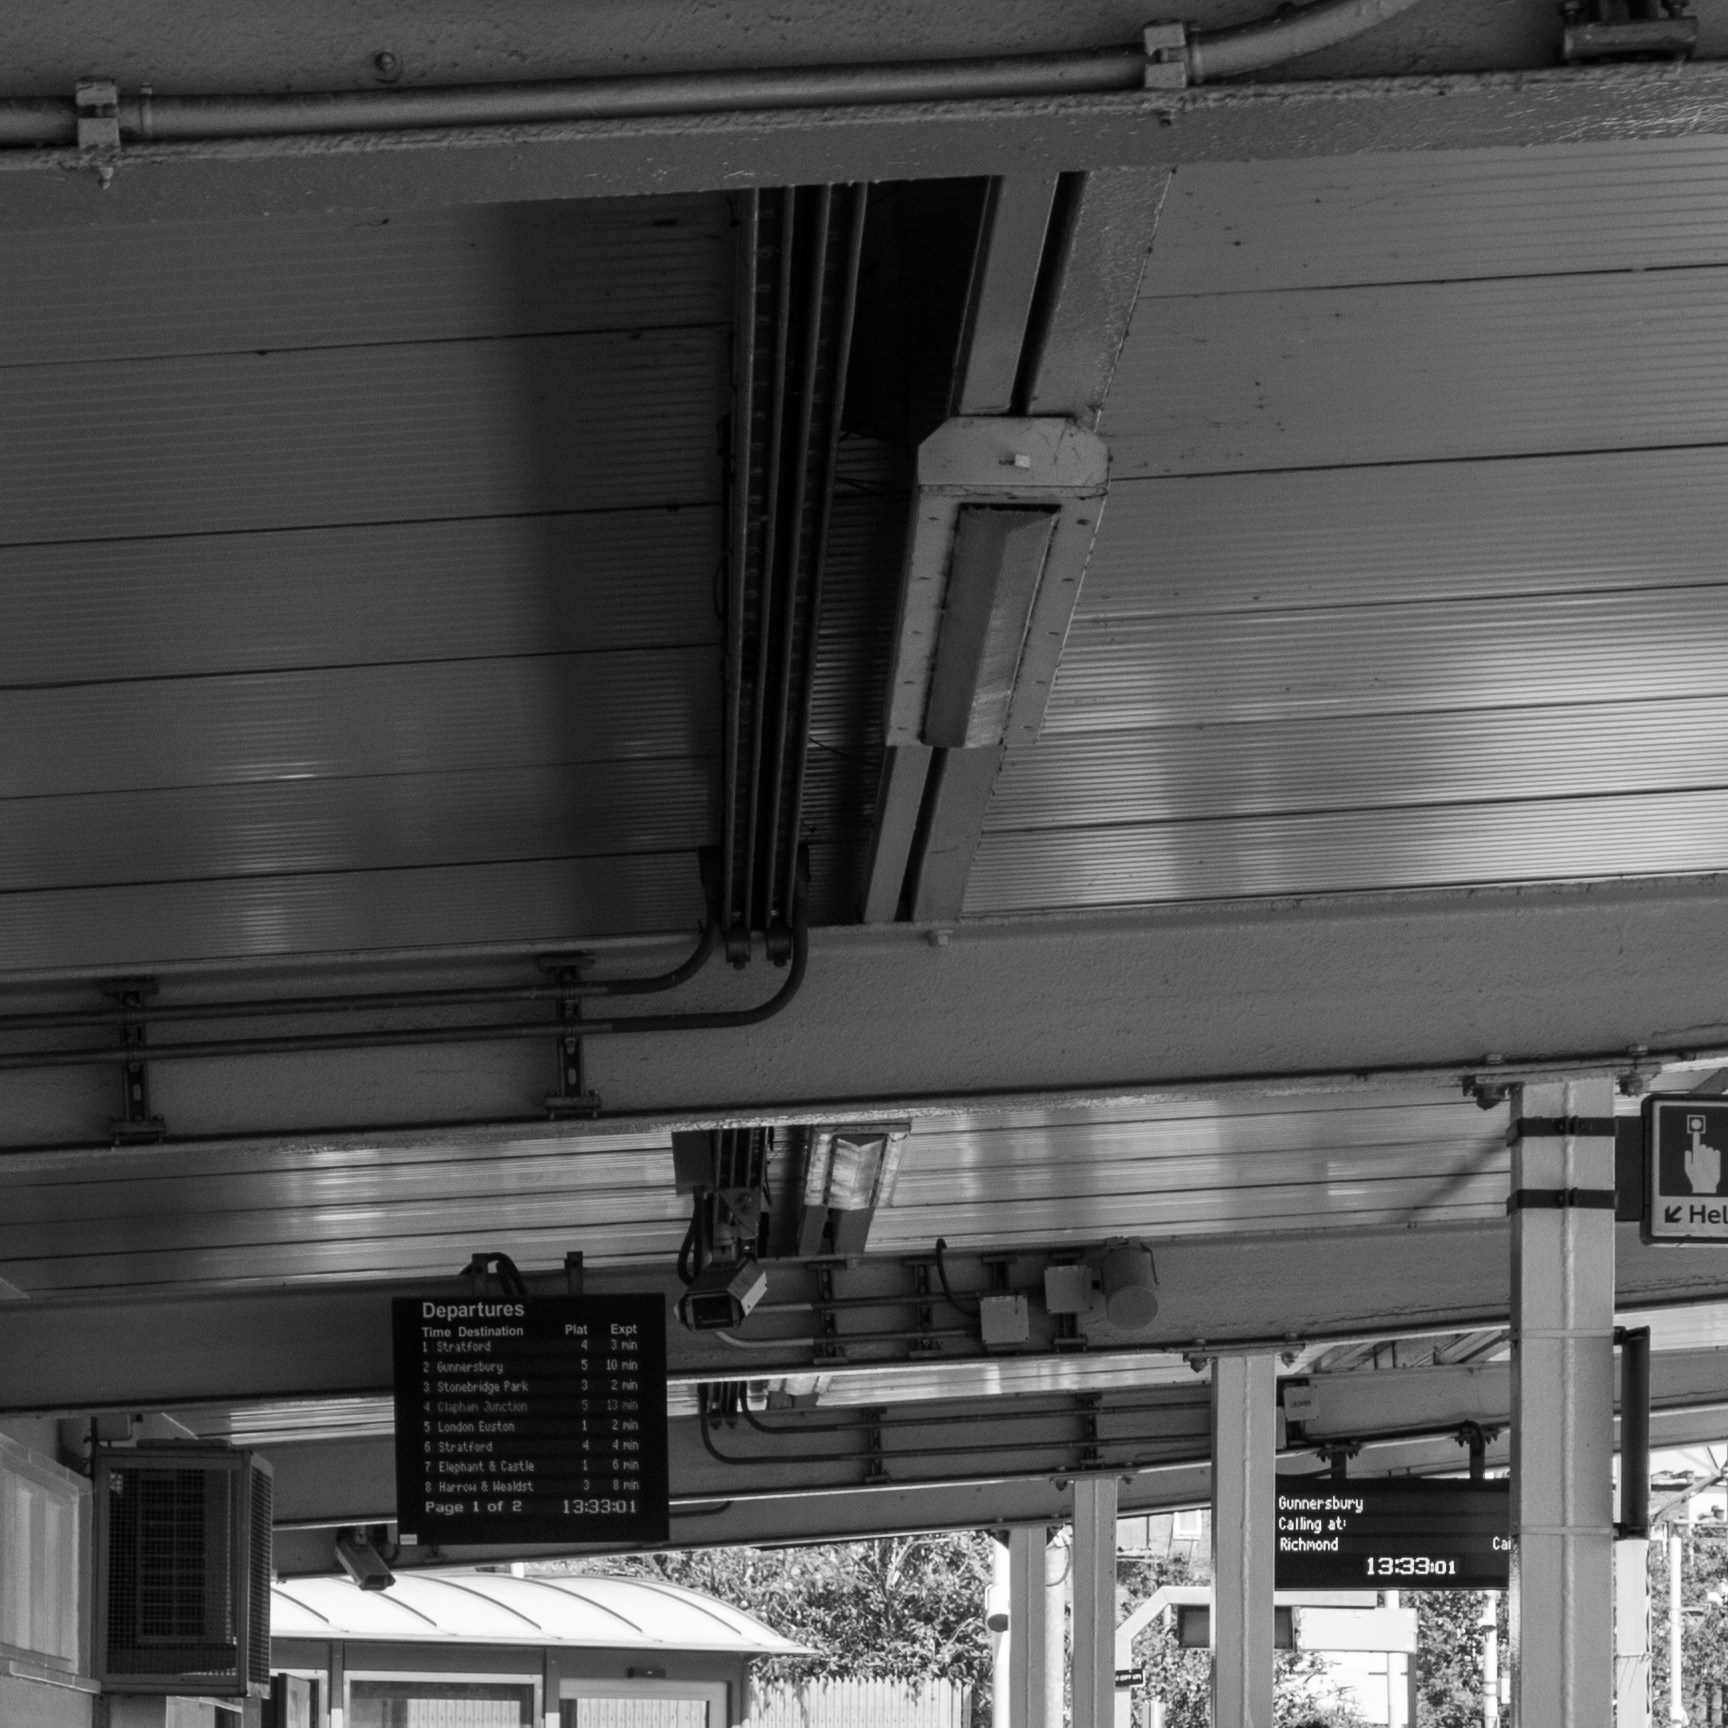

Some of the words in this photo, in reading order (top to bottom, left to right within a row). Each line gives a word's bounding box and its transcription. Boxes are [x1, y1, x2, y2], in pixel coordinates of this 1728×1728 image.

[422, 1302, 525, 1321] Departures
[422, 1327, 451, 1338] Time
[458, 1326, 524, 1337] Destination
[564, 1324, 588, 1335] Plat
[610, 1323, 638, 1337] Expt
[422, 1342, 428, 1353] 1
[436, 1342, 491, 1353] Stratford
[581, 1339, 588, 1350] 4
[611, 1339, 618, 1350] 3
[621, 1339, 638, 1350] min
[423, 1361, 429, 1372] 2
[437, 1361, 503, 1374] Gunnersbury
[581, 1360, 588, 1371] 5
[606, 1360, 618, 1371] 10
[622, 1360, 638, 1370] min
[423, 1381, 430, 1395] 3
[437, 1381, 500, 1395] Stonebridge
[504, 1381, 529, 1395] Park
[582, 1380, 589, 1391] 3
[611, 1380, 619, 1391] 2
[622, 1380, 638, 1391] min
[424, 1401, 430, 1414] 4
[438, 1401, 479, 1414] Clapham
[484, 1401, 528, 1414] Junction
[582, 1400, 589, 1412] 5
[607, 1400, 619, 1412] 13
[622, 1400, 638, 1411] min
[424, 1421, 431, 1433] 5
[438, 1421, 474, 1433] London
[478, 1421, 515, 1433] Euston
[582, 1420, 590, 1431] 1
[612, 1420, 619, 1431] 2
[622, 1420, 639, 1431] min
[425, 1441, 431, 1453] 6
[439, 1441, 493, 1453] Stratford
[583, 1440, 590, 1451] 4
[612, 1440, 619, 1451] 4
[623, 1440, 639, 1450] min
[425, 1460, 432, 1473] 7
[439, 1460, 484, 1475] Elephant
[500, 1460, 535, 1472] Castle
[583, 1459, 590, 1471] 1
[613, 1459, 620, 1471] 6
[623, 1459, 639, 1470] min
[426, 1481, 432, 1493] 8
[439, 1481, 477, 1493] Harrow
[493, 1481, 534, 1493] Wealdst
[584, 1480, 591, 1491] 3
[613, 1480, 620, 1491] 8
[623, 1480, 639, 1490] min
[425, 1501, 464, 1515] Page
[473, 1501, 479, 1511] 1
[487, 1500, 504, 1511] of
[512, 1500, 523, 1511] 2
[563, 1499, 637, 1514] 13:33:01
[1278, 1496, 1363, 1513] Gunnersbury
[1278, 1517, 1322, 1533] Calling
[1328, 1518, 1346, 1530] at:
[1280, 1538, 1339, 1551] Richmond
[1367, 1557, 1456, 1575] 13:33:01
